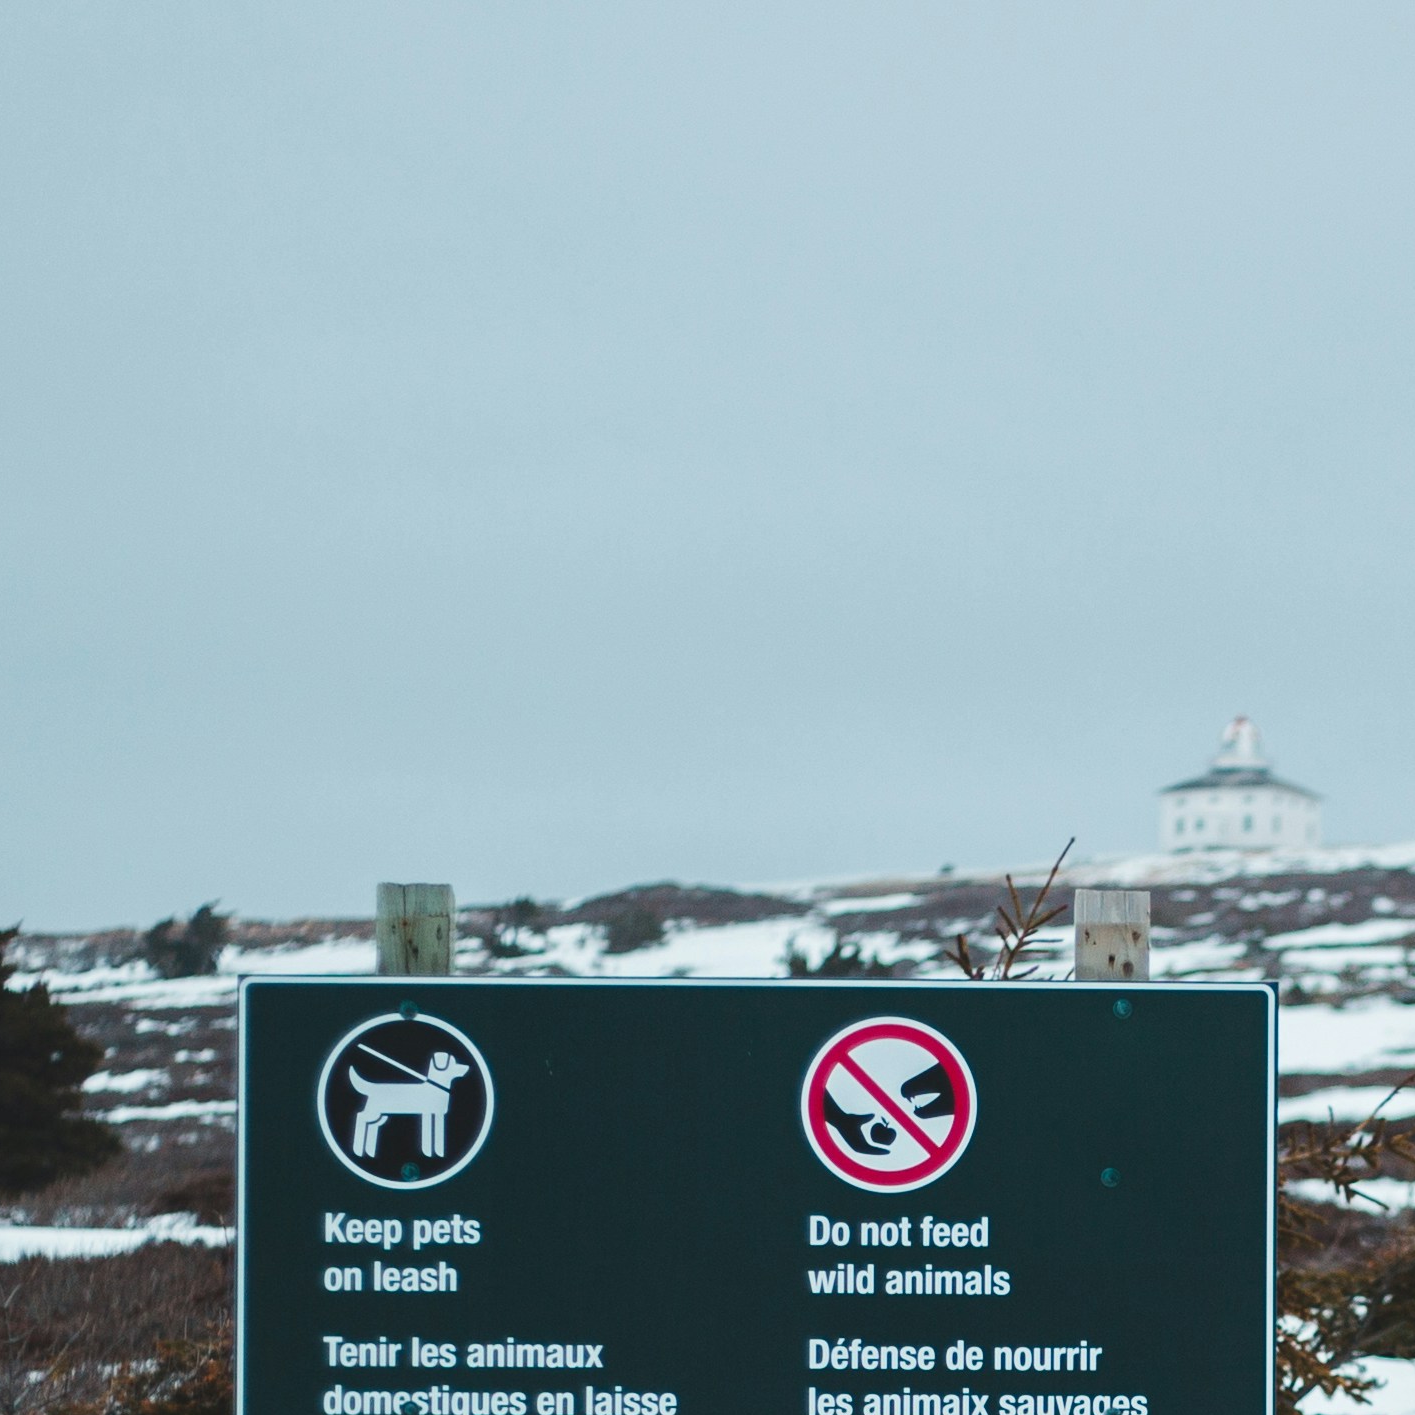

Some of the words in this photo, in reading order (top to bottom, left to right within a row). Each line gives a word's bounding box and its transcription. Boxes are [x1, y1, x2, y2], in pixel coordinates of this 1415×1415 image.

[325, 1212, 403, 1250] Keep
[412, 1213, 481, 1251] pets
[809, 1215, 850, 1247] Do
[860, 1217, 913, 1248] not
[920, 1215, 989, 1248] feed
[323, 1267, 363, 1292] on
[373, 1261, 458, 1293] leash
[808, 1262, 875, 1295] wild
[885, 1263, 1011, 1296] animals
[322, 1336, 403, 1368] Tenir
[411, 1337, 457, 1369] les
[466, 1337, 604, 1369] animaux
[808, 1337, 936, 1371] Défense
[945, 1339, 984, 1371] de
[993, 1340, 1103, 1372] nourrir
